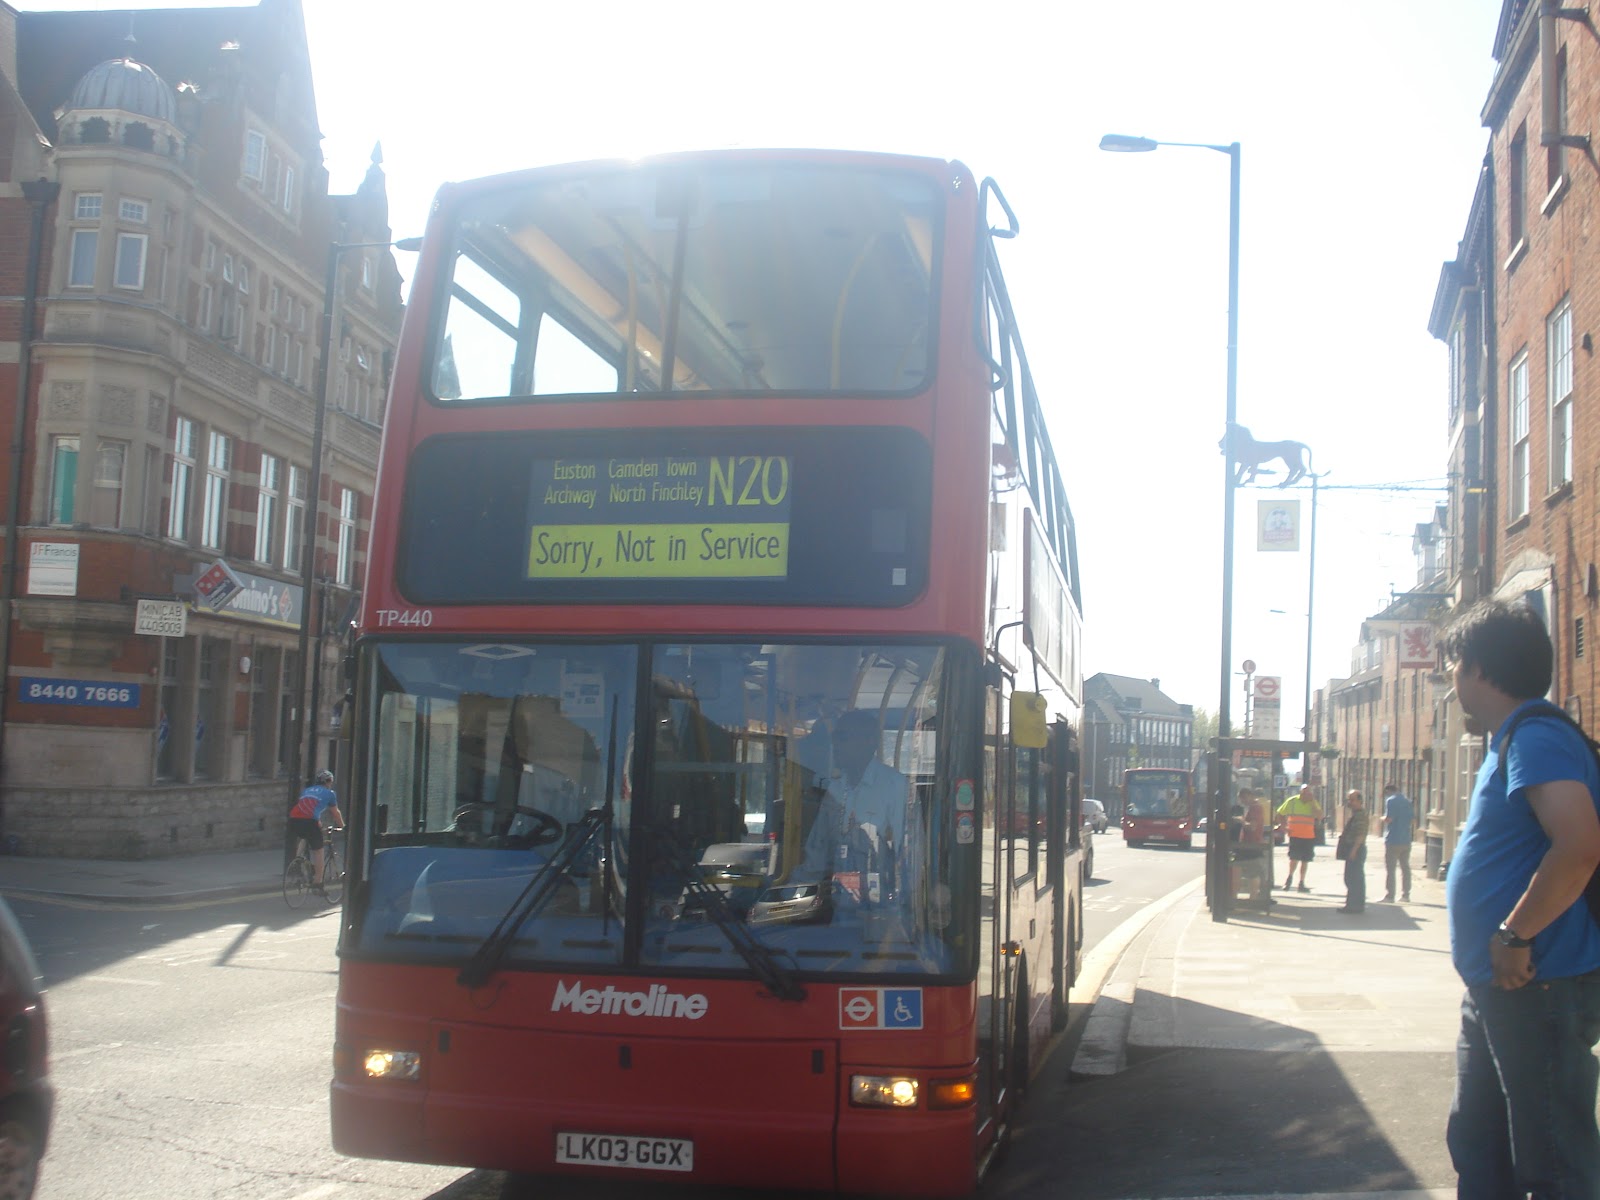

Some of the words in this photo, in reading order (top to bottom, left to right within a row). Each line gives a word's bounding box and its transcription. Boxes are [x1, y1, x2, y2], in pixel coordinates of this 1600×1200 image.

[553, 459, 596, 480] Euston
[608, 457, 659, 479] Camden
[666, 457, 697, 477] Town
[707, 455, 789, 506] N20
[544, 484, 597, 509] Archway
[609, 482, 646, 503] North
[651, 481, 704, 507] Finchley
[536, 532, 602, 573] Sorry,
[615, 530, 656, 563] Not
[668, 534, 686, 561] in
[699, 527, 780, 560] Service
[228, 579, 278, 616] omino's
[376, 609, 433, 627] TP440
[30, 683, 77, 700] 8440
[84, 687, 130, 702] 7666
[551, 979, 709, 1020] Metroline
[565, 1135, 629, 1162] LK03
[636, 1141, 684, 1167] GGX
